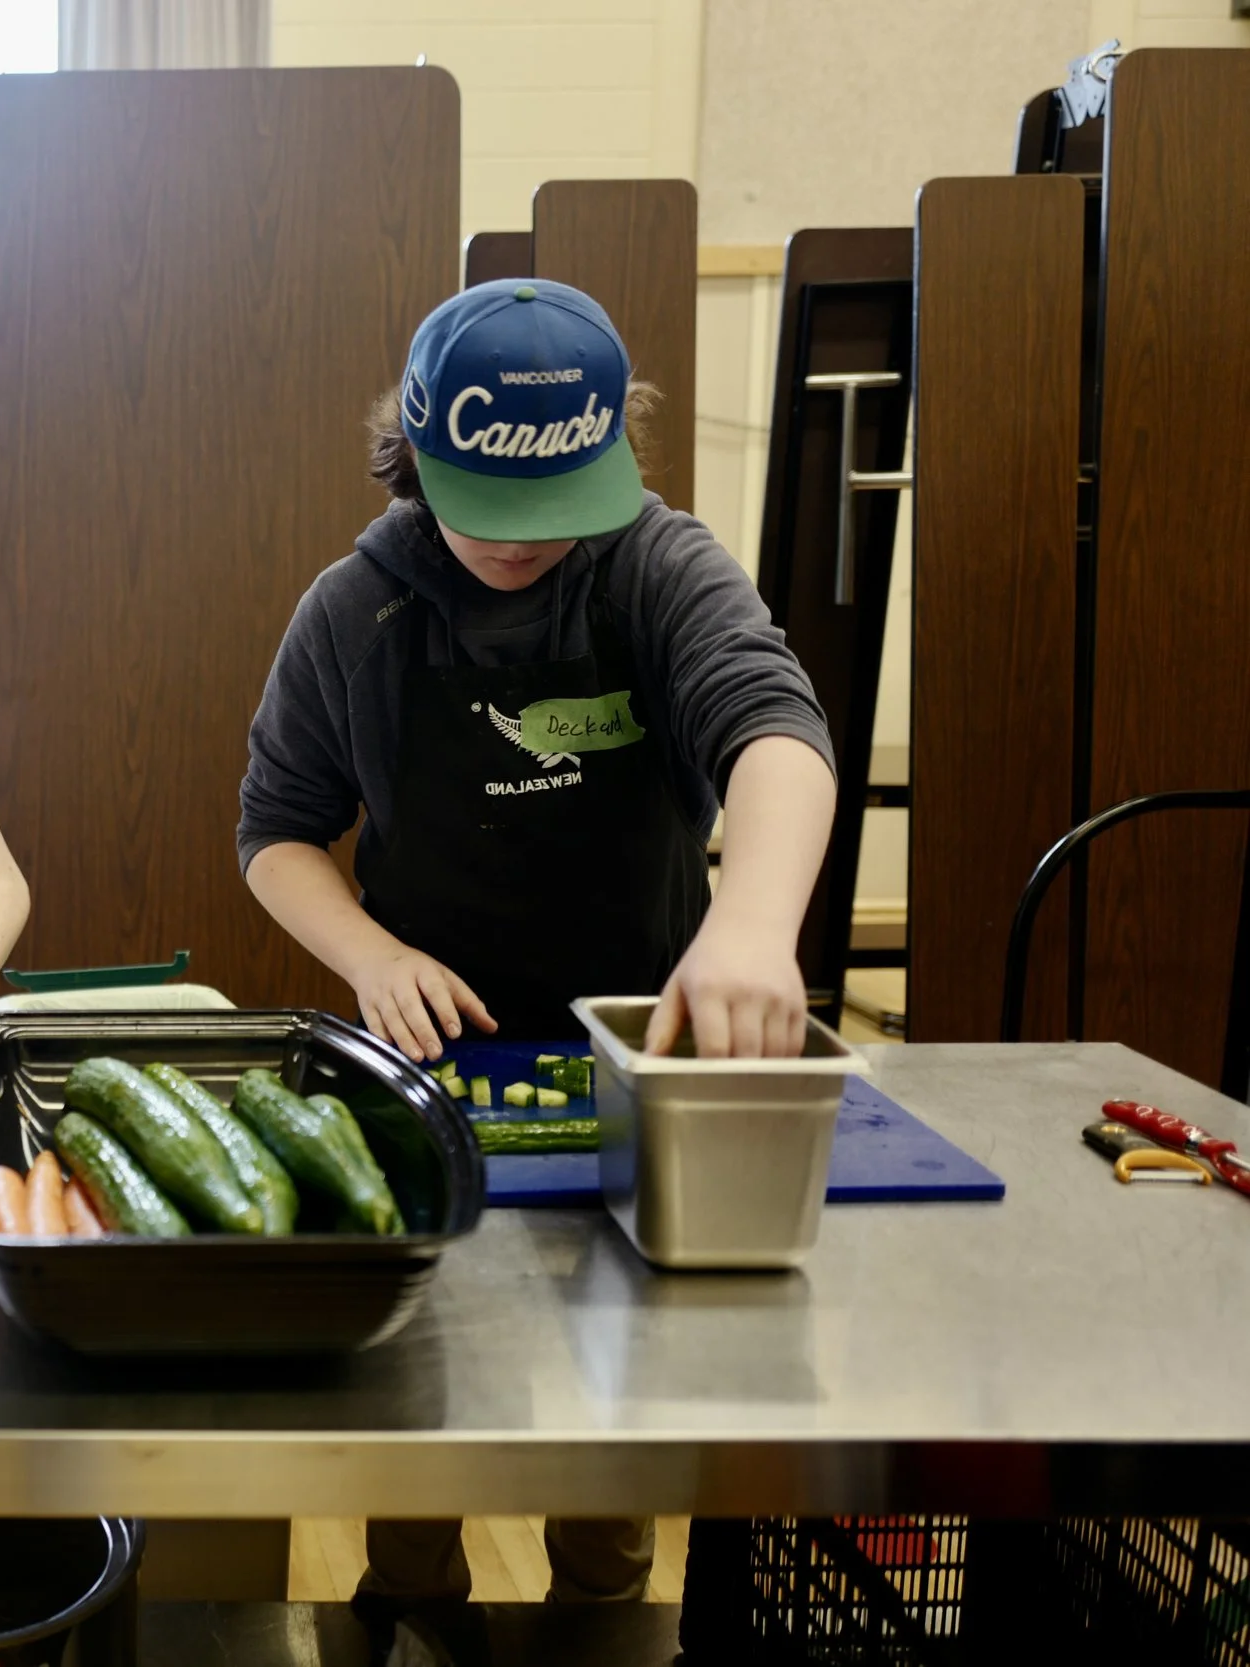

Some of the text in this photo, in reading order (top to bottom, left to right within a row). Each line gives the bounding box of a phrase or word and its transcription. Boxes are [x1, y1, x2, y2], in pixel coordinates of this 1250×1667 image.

[500, 368, 583, 385] VANCOUVER
[448, 386, 614, 459] Canucks
[547, 710, 623, 737] Deckard
